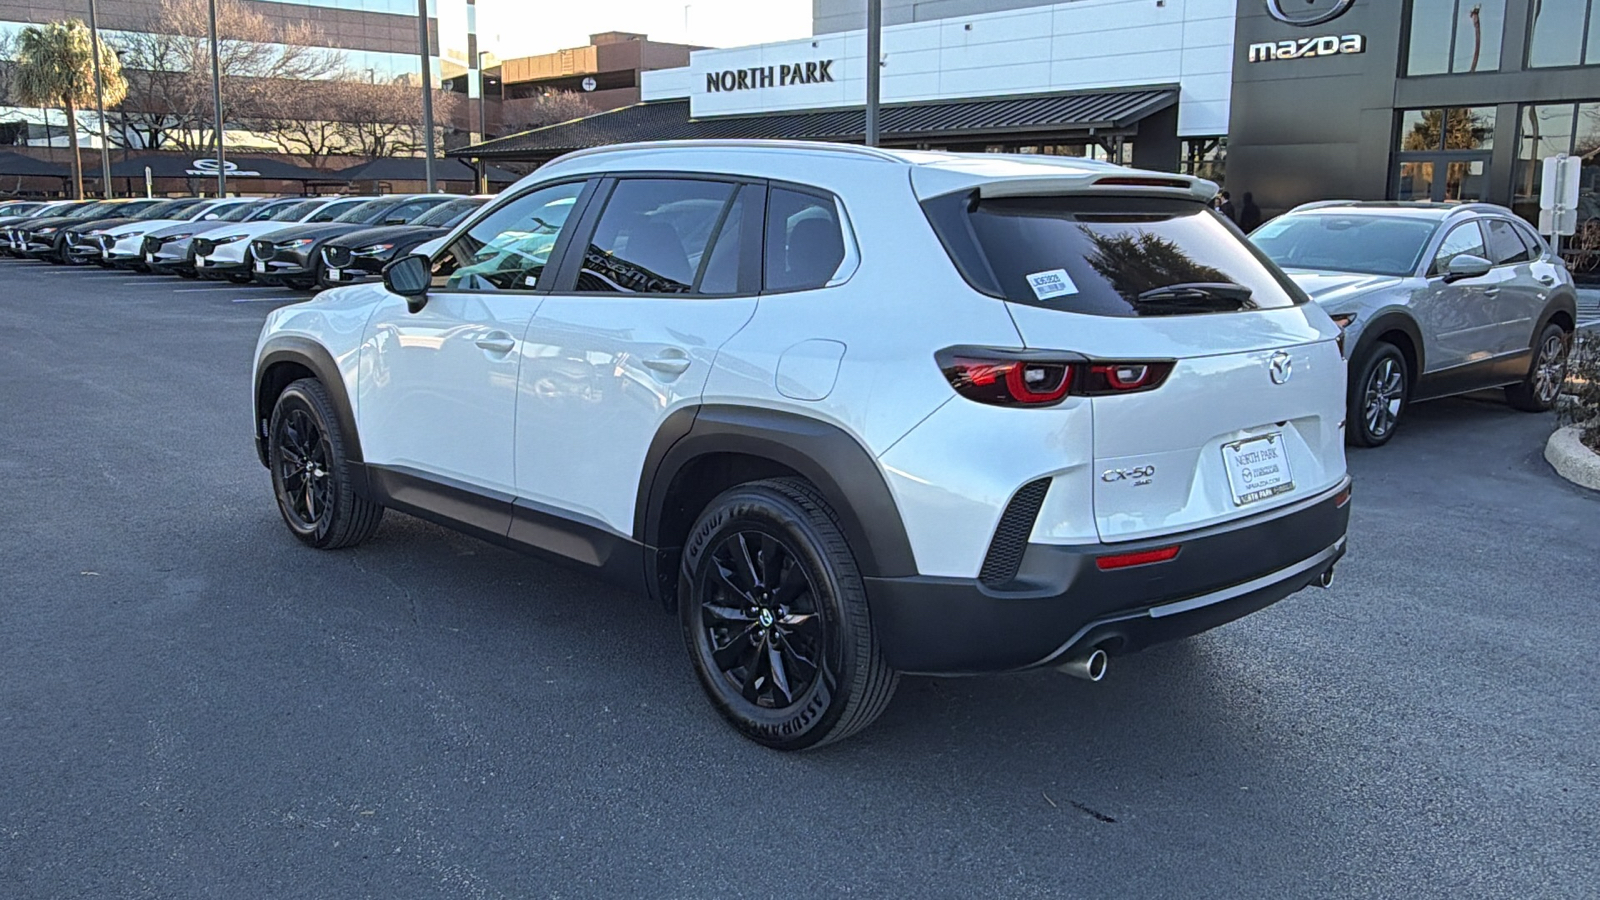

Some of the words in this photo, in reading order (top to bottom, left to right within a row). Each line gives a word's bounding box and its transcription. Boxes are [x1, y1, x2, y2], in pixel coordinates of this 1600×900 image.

[706, 66, 774, 93] NORTH
[779, 59, 834, 86] PARK
[1235, 450, 1261, 467] NORTH
[1260, 447, 1279, 461] PARK
[1101, 465, 1155, 483] CX-50
